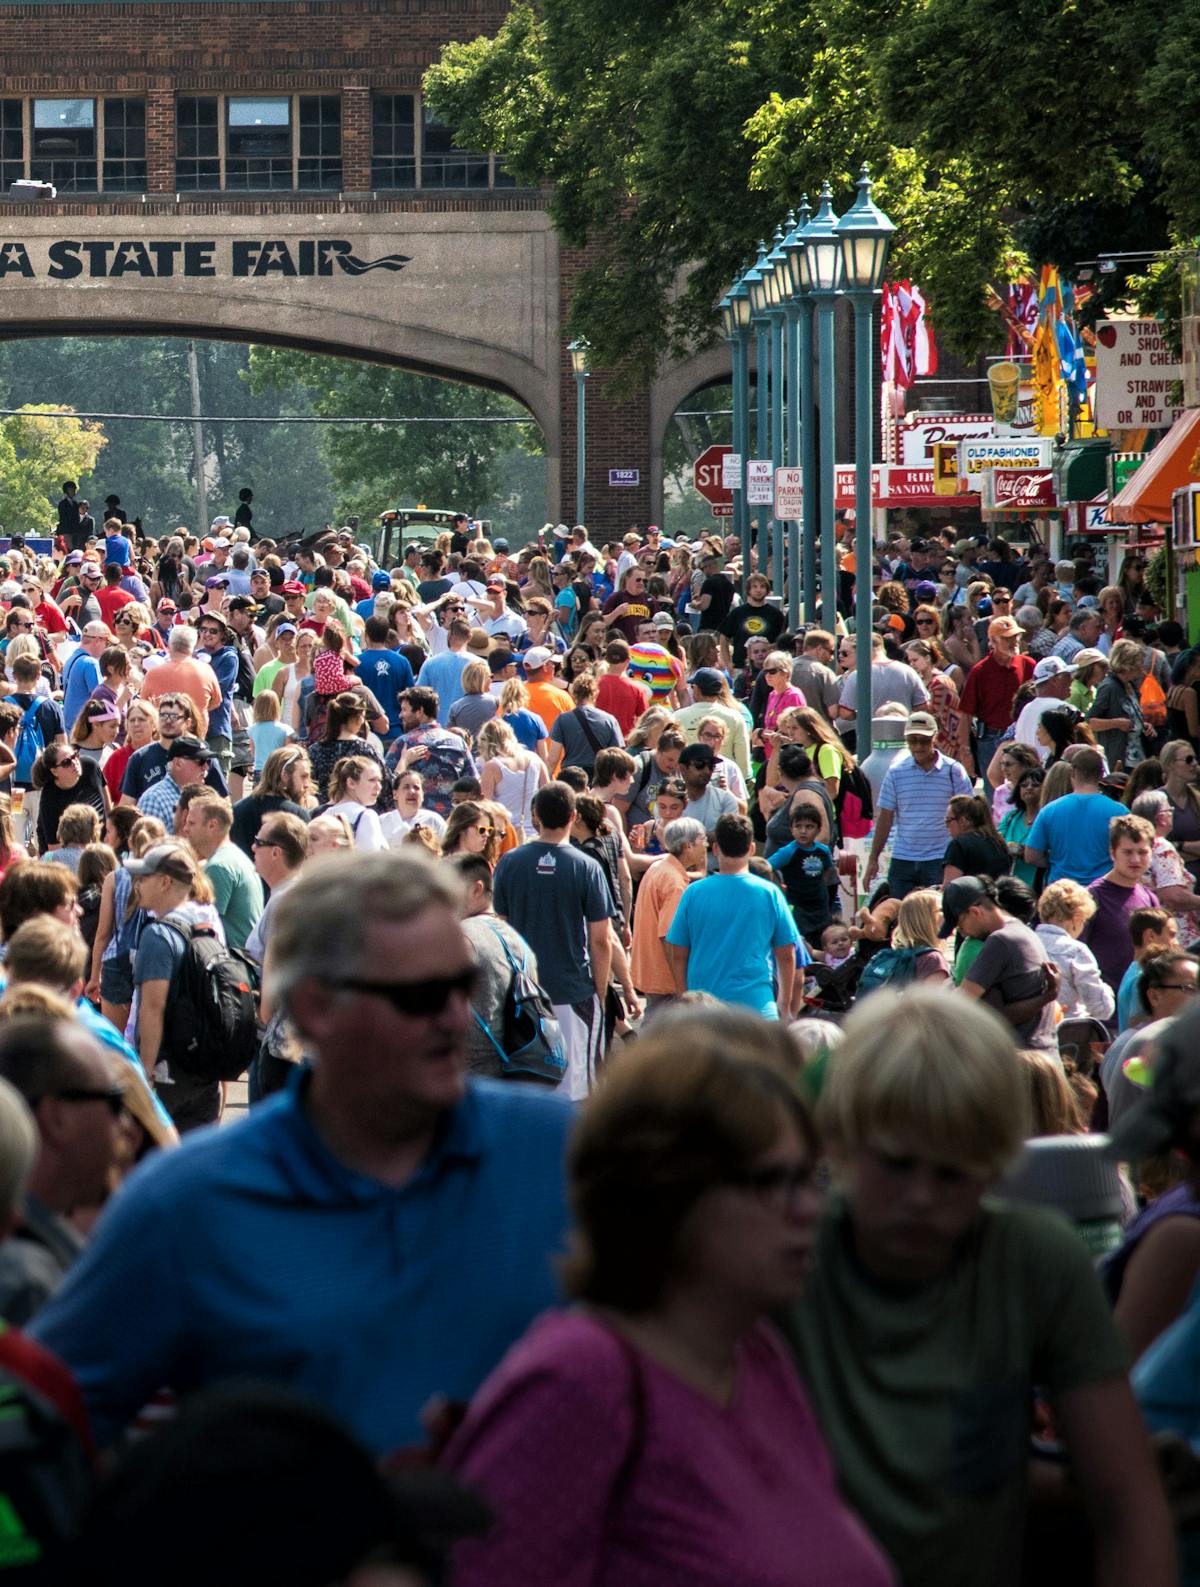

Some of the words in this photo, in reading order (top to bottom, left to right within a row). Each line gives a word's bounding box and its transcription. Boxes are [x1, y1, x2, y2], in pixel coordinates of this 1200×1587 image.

[47, 241, 216, 280] STATE
[232, 240, 411, 277] FAIR
[1120, 353, 1142, 367] AND
[1135, 395, 1155, 408] AND
[1117, 410, 1132, 423] OR
[1142, 410, 1163, 423] HOT
[967, 447, 986, 458] OLD
[987, 447, 1040, 458] FASHIONED
[616, 470, 634, 479] 1822
[756, 465, 768, 474] NO
[698, 465, 721, 487] ST
[787, 473, 800, 484] NO
[838, 474, 854, 484] ICE
[779, 486, 803, 496] PARKIN
[1016, 498, 1048, 506] CLASSIC
